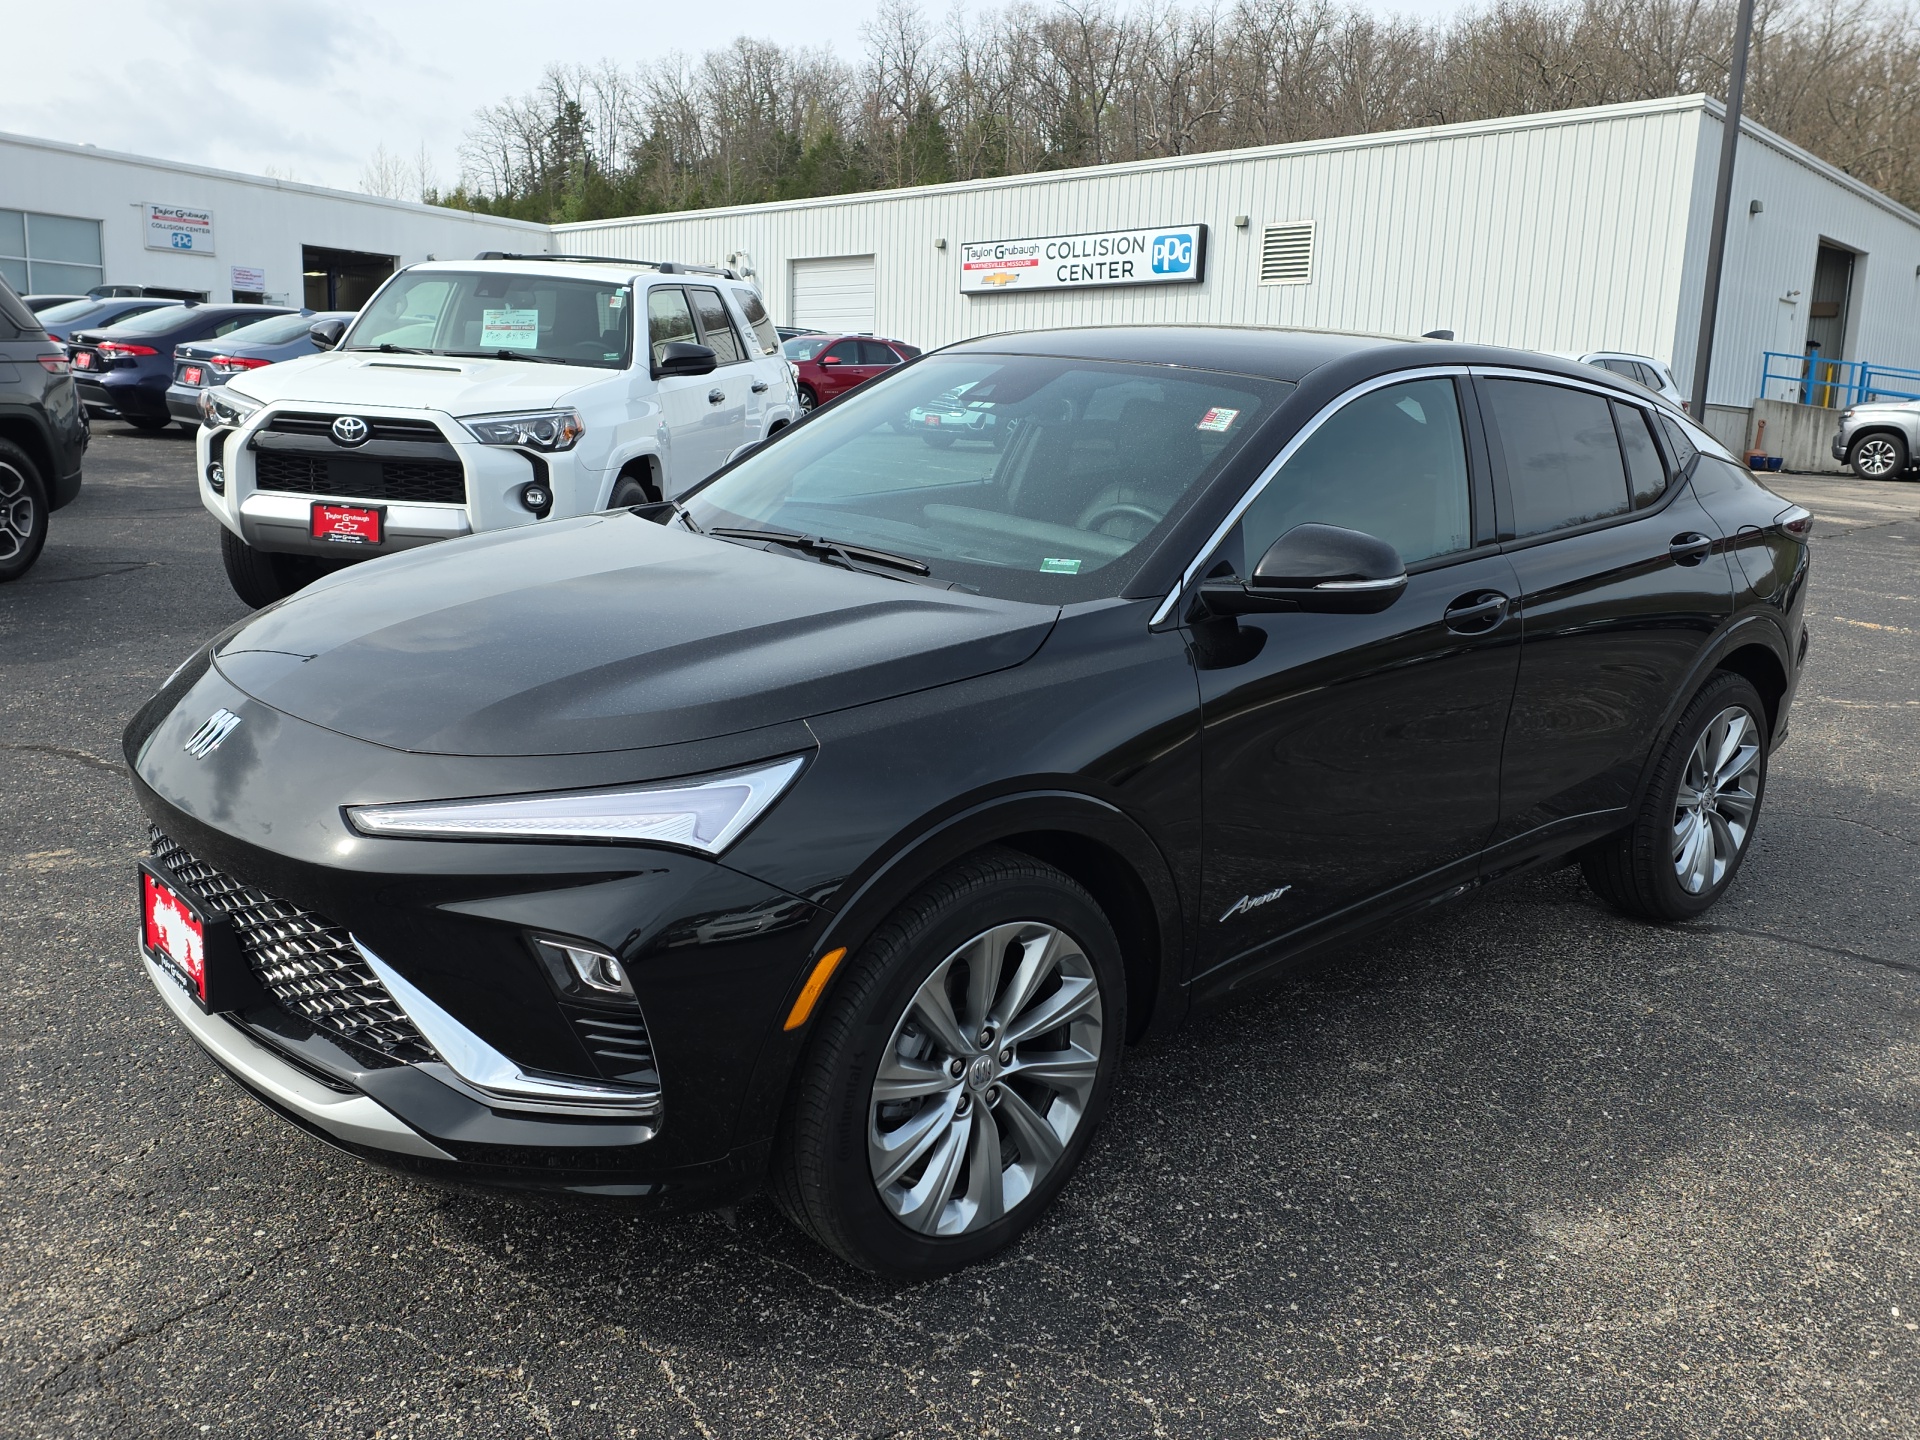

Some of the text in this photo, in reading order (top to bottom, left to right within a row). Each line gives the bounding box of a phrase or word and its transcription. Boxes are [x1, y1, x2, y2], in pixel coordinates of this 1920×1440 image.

[152, 206, 209, 220] Taylor Grubaugh
[152, 222, 184, 231] COLLISION
[172, 233, 192, 247] PPG
[963, 243, 1040, 262] Taylor Grubaugh
[1045, 235, 1146, 260] COLLISION
[1152, 237, 1191, 271] PPG
[1006, 259, 1031, 267] MISSOURI
[1056, 260, 1135, 282] CENTER
[324, 512, 370, 522] Taylor Grubaugh
